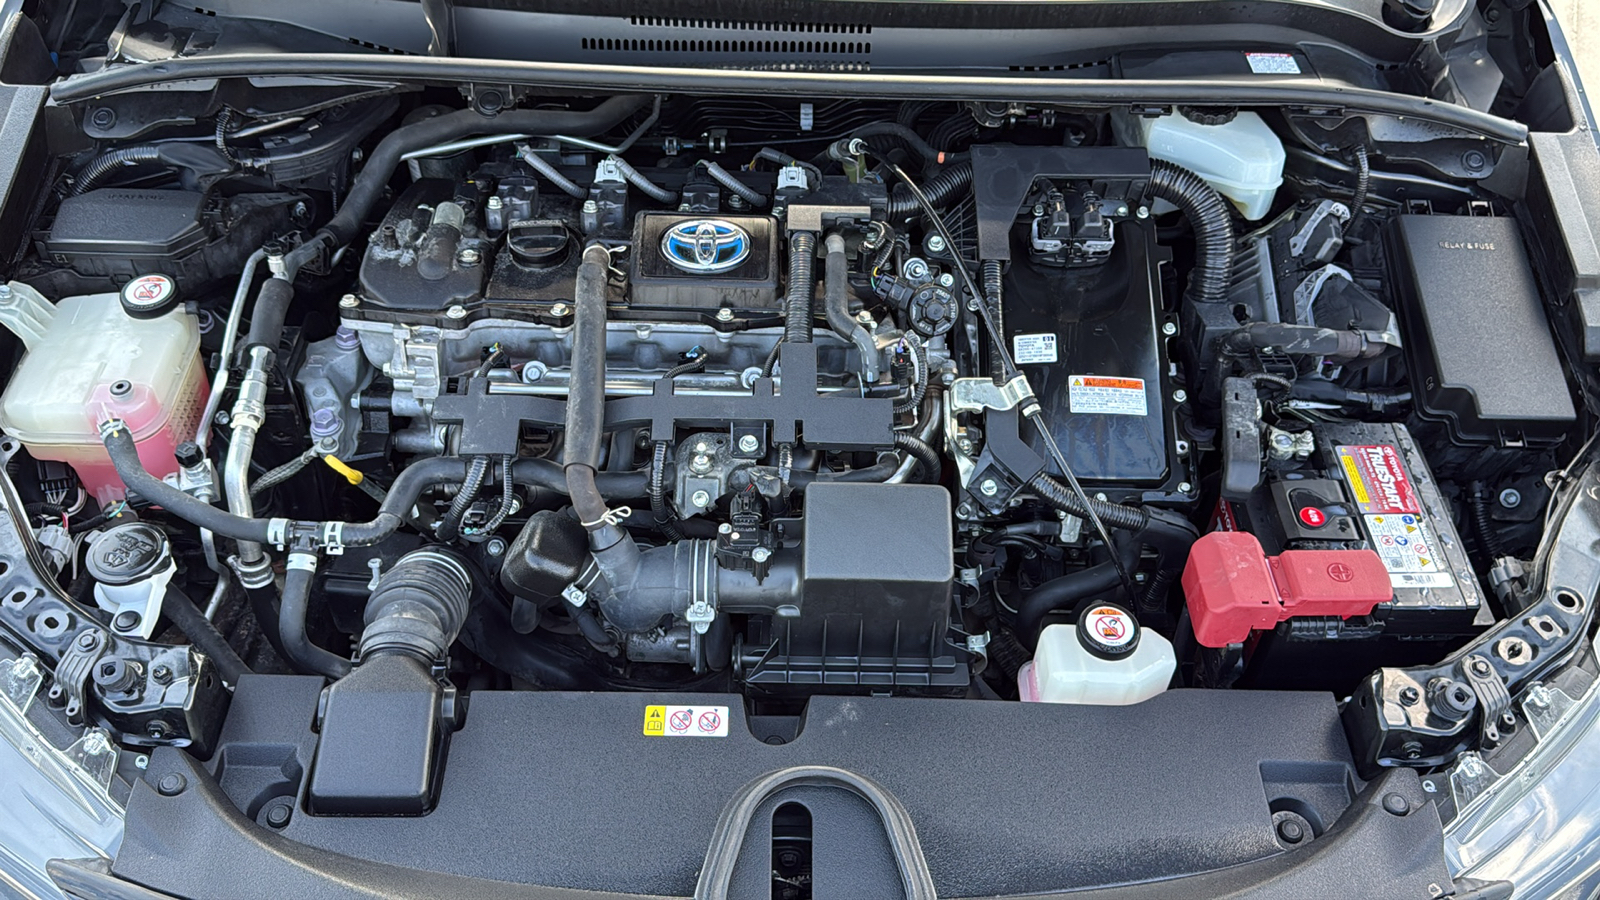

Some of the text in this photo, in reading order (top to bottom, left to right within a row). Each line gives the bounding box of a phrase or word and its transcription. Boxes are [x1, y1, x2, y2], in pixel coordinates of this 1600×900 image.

[1438, 241, 1496, 250] RELAY & FUSE
[1388, 456, 1404, 482] TOYOTA
